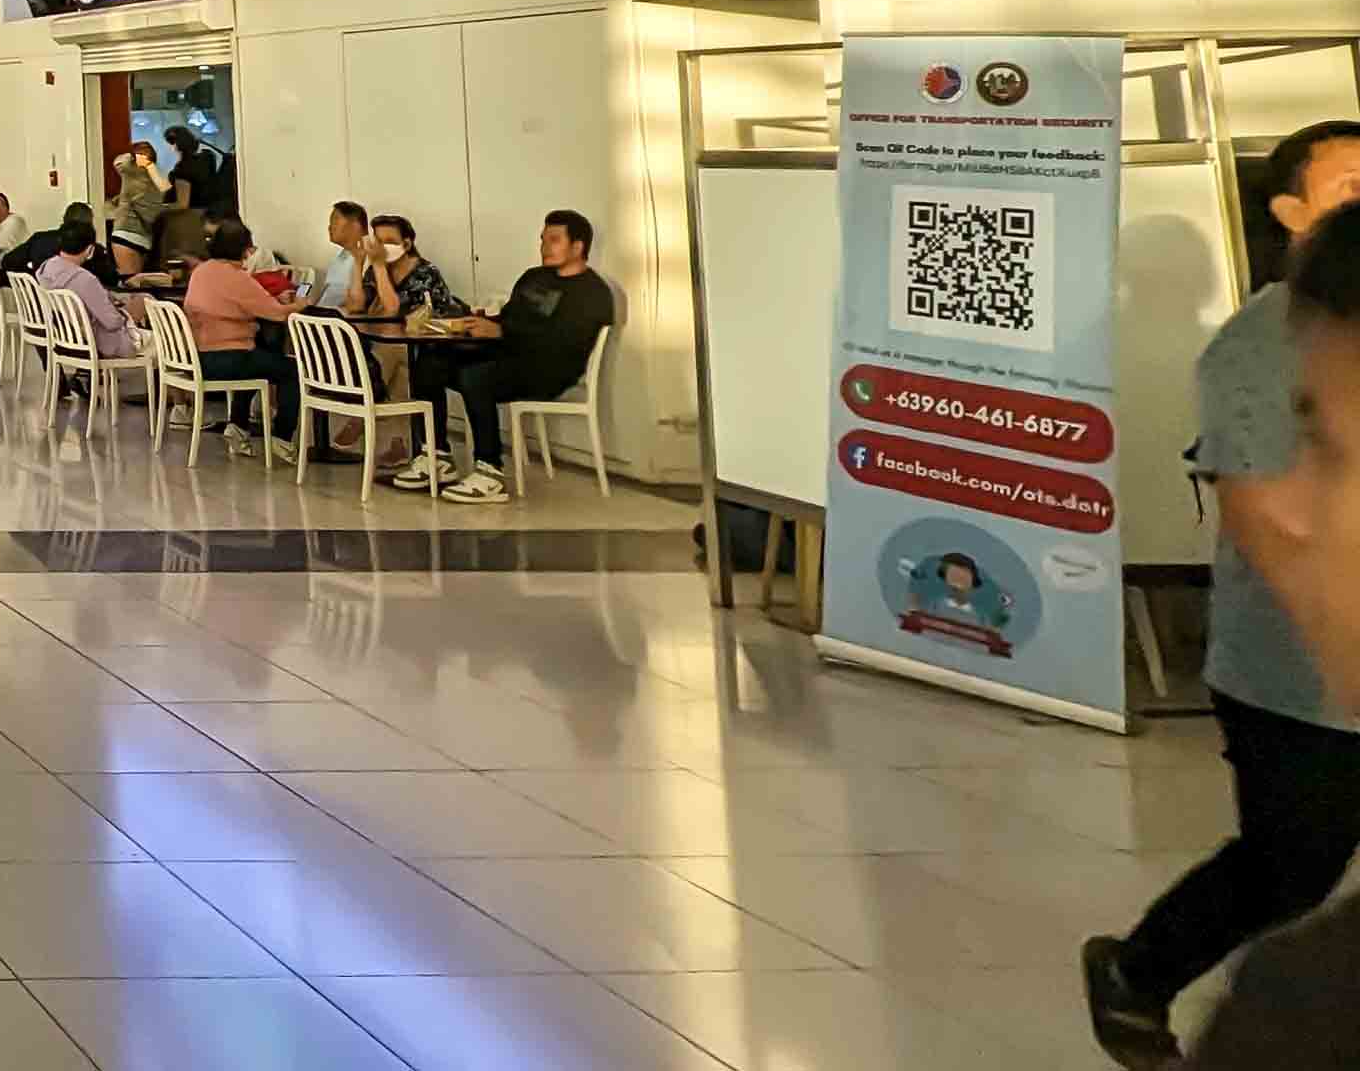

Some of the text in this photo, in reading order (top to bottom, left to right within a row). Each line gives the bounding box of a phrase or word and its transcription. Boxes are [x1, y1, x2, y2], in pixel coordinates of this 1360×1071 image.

[855, 142, 885, 153] Scan
[906, 144, 939, 155] Code
[957, 145, 995, 159] place
[998, 150, 1029, 162] your
[884, 390, 1088, 443] +63960-461-6877
